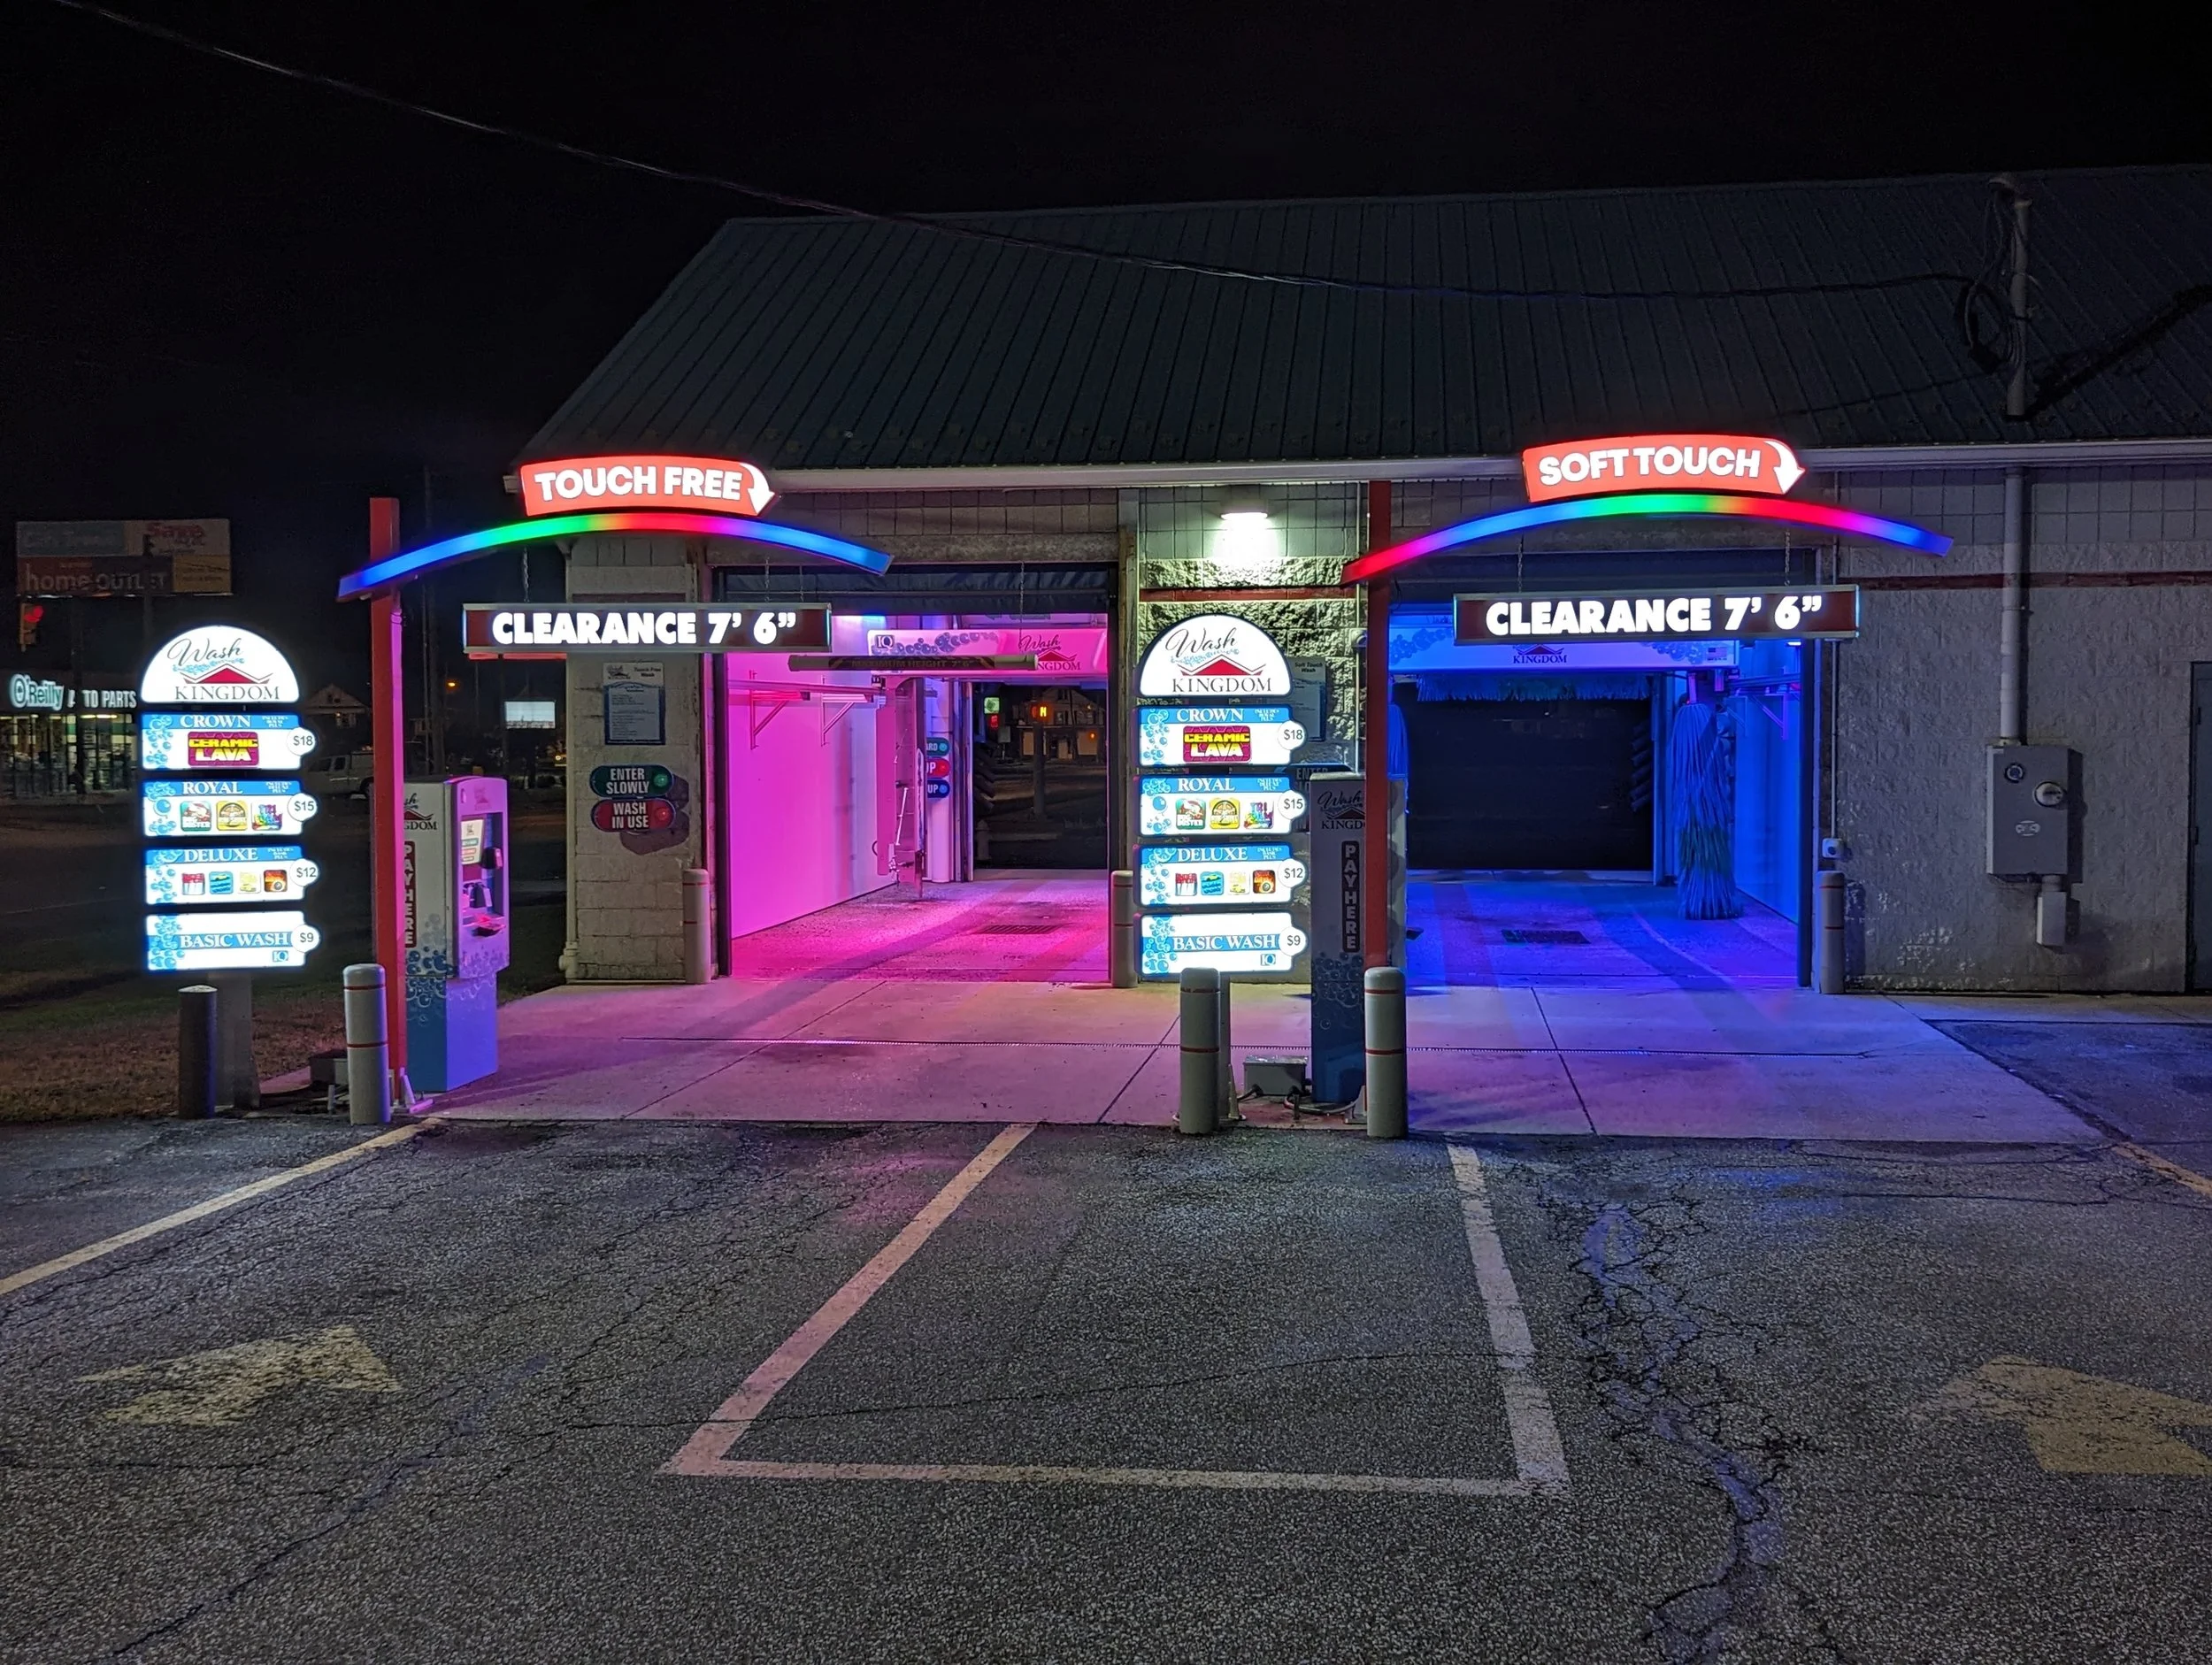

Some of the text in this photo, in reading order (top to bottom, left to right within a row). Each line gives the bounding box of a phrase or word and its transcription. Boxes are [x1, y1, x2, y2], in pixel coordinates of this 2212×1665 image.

[1539, 446, 1761, 486] SOFT TOUCH
[534, 465, 742, 502] TOUCH FREE
[1485, 595, 1822, 635] CLEARANCE 7' 6"
[492, 612, 796, 645] CLEARANCE 7' 6"
[877, 635, 893, 649] IQ
[1018, 634, 1060, 651] Wash
[1165, 627, 1237, 658] Wash
[167, 638, 244, 665] Wash
[1512, 654, 1567, 664] KINGDOM
[1038, 662, 1080, 671] NGDOM
[9, 673, 65, 710] O'Reilly
[101, 690, 137, 709] PARTS
[1171, 678, 1271, 693] KINGDOM
[175, 686, 280, 700] KINGDOM
[180, 715, 251, 728] CROWN
[1176, 709, 1244, 722] CROWN
[293, 735, 313, 747] $18
[1184, 733, 1250, 742] CERAMIC
[1283, 729, 1303, 740] $18
[188, 739, 258, 748] CERAMIC
[1190, 743, 1243, 756] LAVA
[195, 748, 251, 761] LAVA
[610, 768, 645, 780] ENTER
[182, 781, 243, 794] ROYAL
[606, 781, 649, 794] SLOWLY
[927, 784, 939, 794] UP
[1178, 779, 1235, 792] ROYAL
[294, 801, 315, 811] $15
[613, 802, 647, 815] WASH
[1284, 798, 1303, 809] $15
[611, 816, 649, 829] IN USE
[1322, 820, 1365, 830] KINGD
[184, 848, 258, 863] DELUXE
[1178, 847, 1248, 862] DELUXE
[296, 867, 317, 878] $12
[1284, 867, 1303, 879] $12
[1344, 845, 1357, 949] PAY HERE
[180, 932, 288, 948] BASIC WASH
[299, 932, 314, 943] $9
[1173, 934, 1276, 951] BASIC WASH
[1286, 934, 1301, 946] $9
